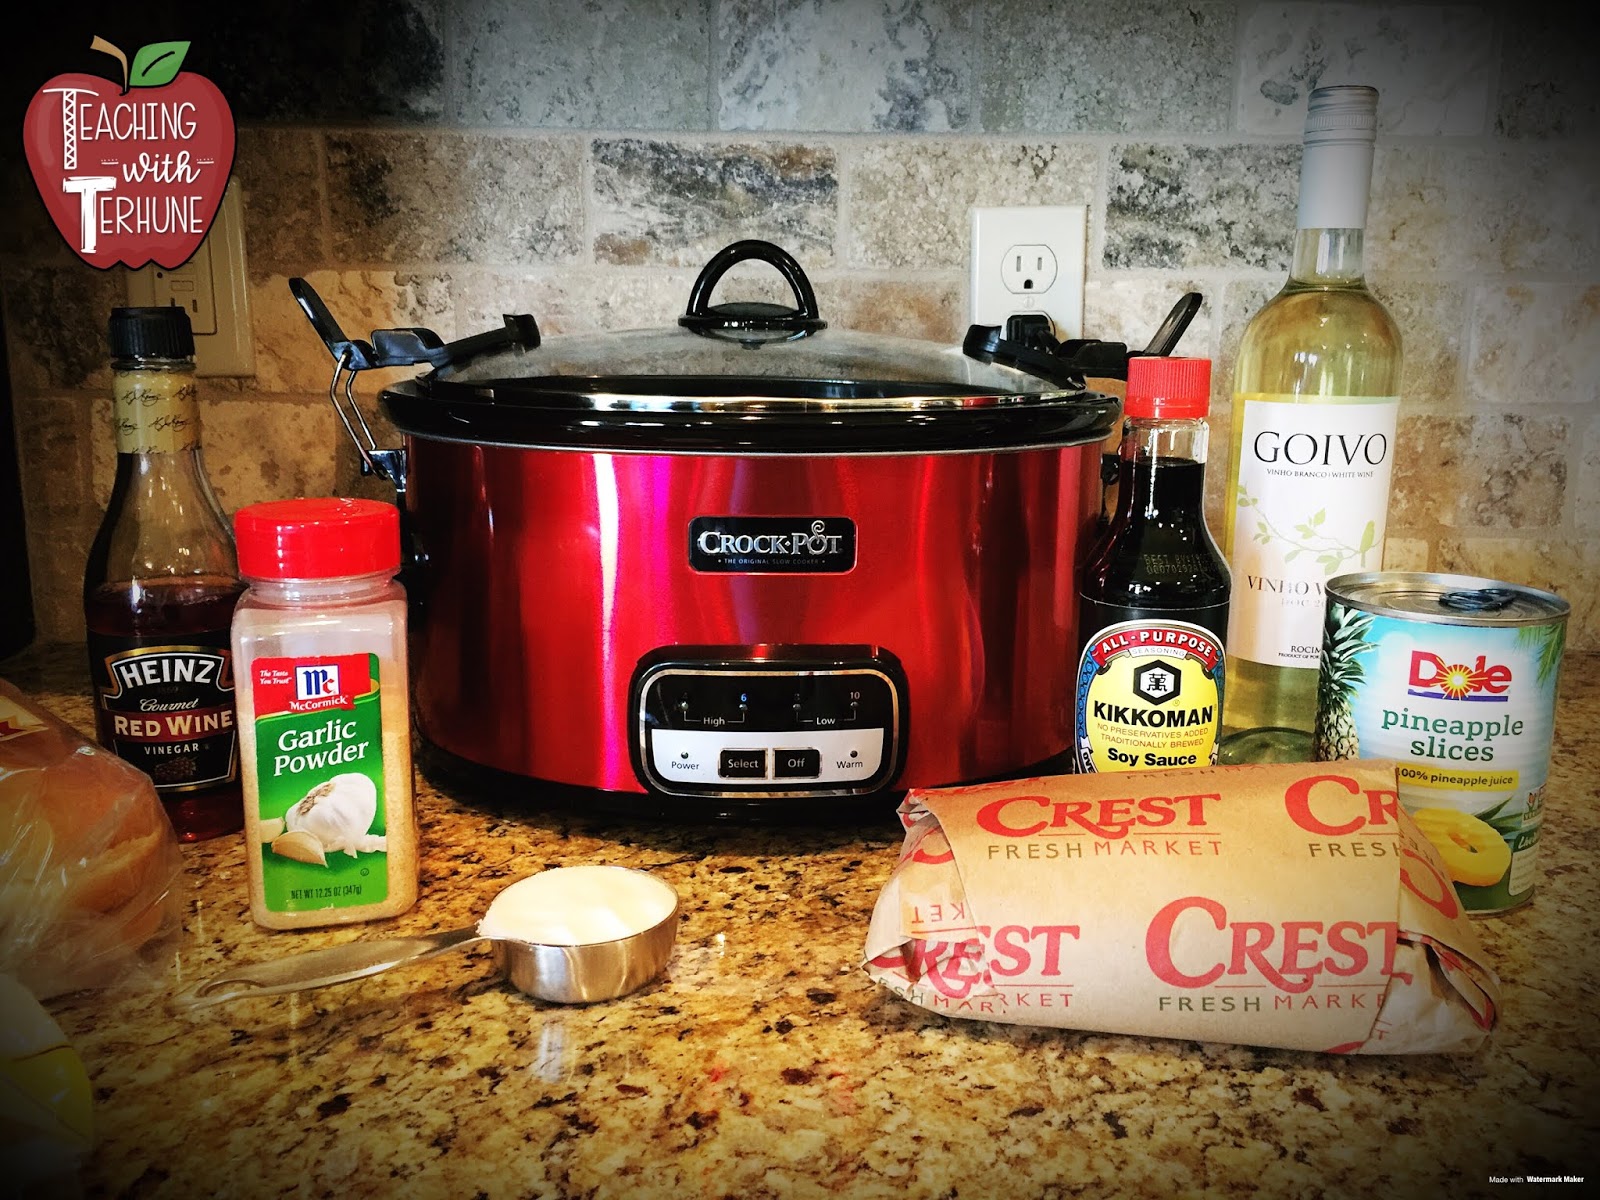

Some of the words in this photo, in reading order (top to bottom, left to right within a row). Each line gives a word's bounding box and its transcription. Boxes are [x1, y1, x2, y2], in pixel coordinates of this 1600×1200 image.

[1253, 431, 1387, 466] GOIVO
[1266, 469, 1293, 477] VINHO
[1294, 470, 1329, 478] BRANCO
[772, 558, 791, 566] SLOW
[1131, 646, 1185, 657] SEASONING
[119, 659, 215, 689] HEINZ
[1408, 650, 1512, 696] Dole
[139, 698, 199, 712] Gourmet
[289, 695, 348, 711] McCormick
[740, 693, 747, 702] 6
[849, 691, 861, 700] 10
[114, 715, 161, 737] RED
[165, 710, 233, 736] WINE
[703, 716, 725, 727] High
[816, 716, 836, 726] Low
[1093, 700, 1213, 728] KIKKOMAN
[1097, 723, 1109, 732] NO
[1110, 724, 1182, 739] PRESERVATIVES
[1184, 728, 1209, 738] ADDED
[1381, 708, 1523, 742] pineapple
[278, 719, 356, 752] Garlic
[1100, 733, 1167, 749] TRADITIONALLY
[1170, 738, 1204, 748] BREWED
[144, 743, 199, 755] VINEGAR
[1107, 748, 1139, 767] Soy
[1144, 754, 1197, 767] Sauce
[1410, 736, 1494, 762] slices
[273, 741, 369, 777] Powder
[671, 761, 700, 771] Power
[728, 758, 759, 769] Select
[788, 757, 805, 768] Off
[836, 760, 864, 769] Warm
[1397, 768, 1428, 781] 00%
[1431, 773, 1487, 787] pineapple
[1488, 775, 1513, 787] juice
[976, 793, 1222, 840] CREST
[988, 842, 1083, 860] FRESH
[1094, 840, 1222, 857] MARKET
[290, 890, 303, 900] NET
[303, 889, 314, 899] WT
[315, 887, 332, 898] 12.25
[333, 886, 342, 897] OZ
[342, 884, 363, 897] (347g)
[1145, 896, 1402, 994] CREST
[871, 924, 1080, 999] REST
[1158, 996, 1261, 1012] FRESH
